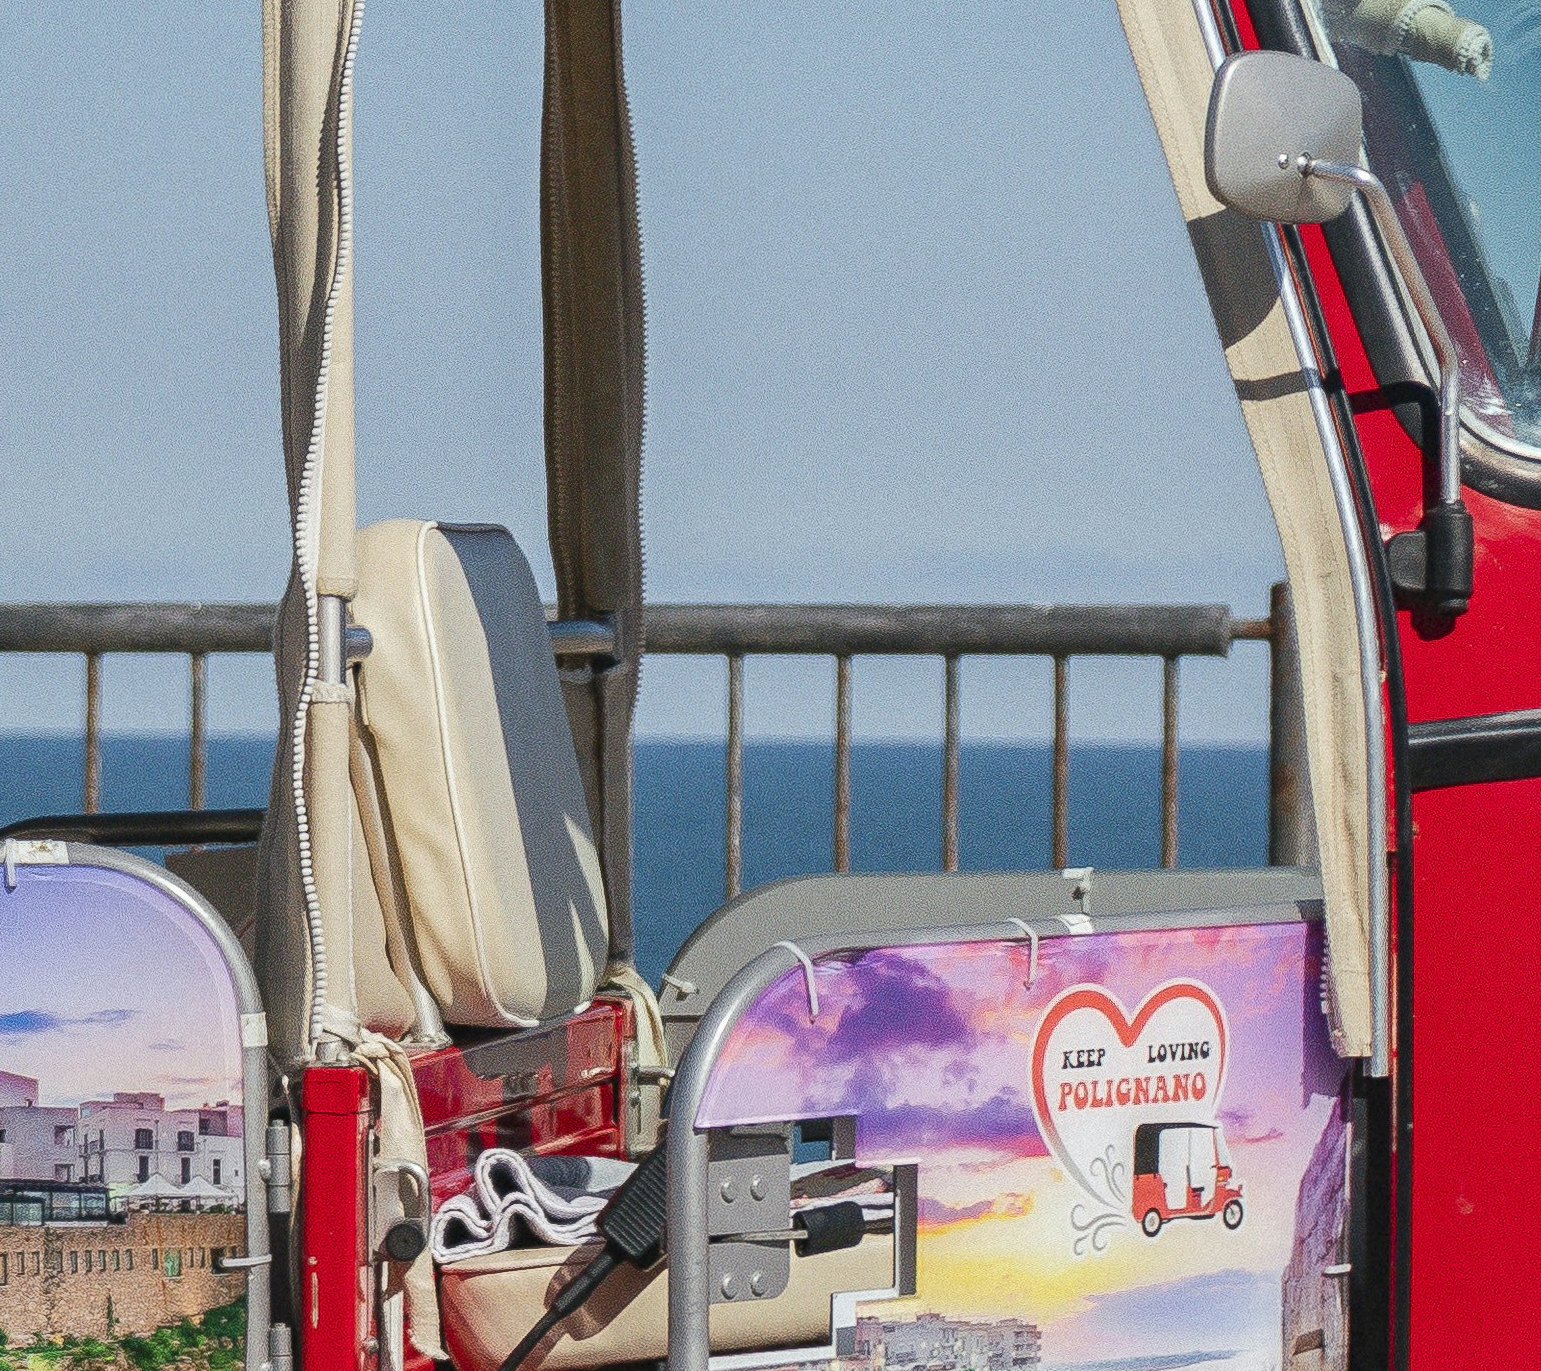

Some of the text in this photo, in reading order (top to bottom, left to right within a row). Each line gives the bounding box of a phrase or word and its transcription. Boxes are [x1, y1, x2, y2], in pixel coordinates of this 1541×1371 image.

[1061, 1041, 1211, 1070] KEEP LOVING
[1059, 1073, 1207, 1111] POLIGNANO
